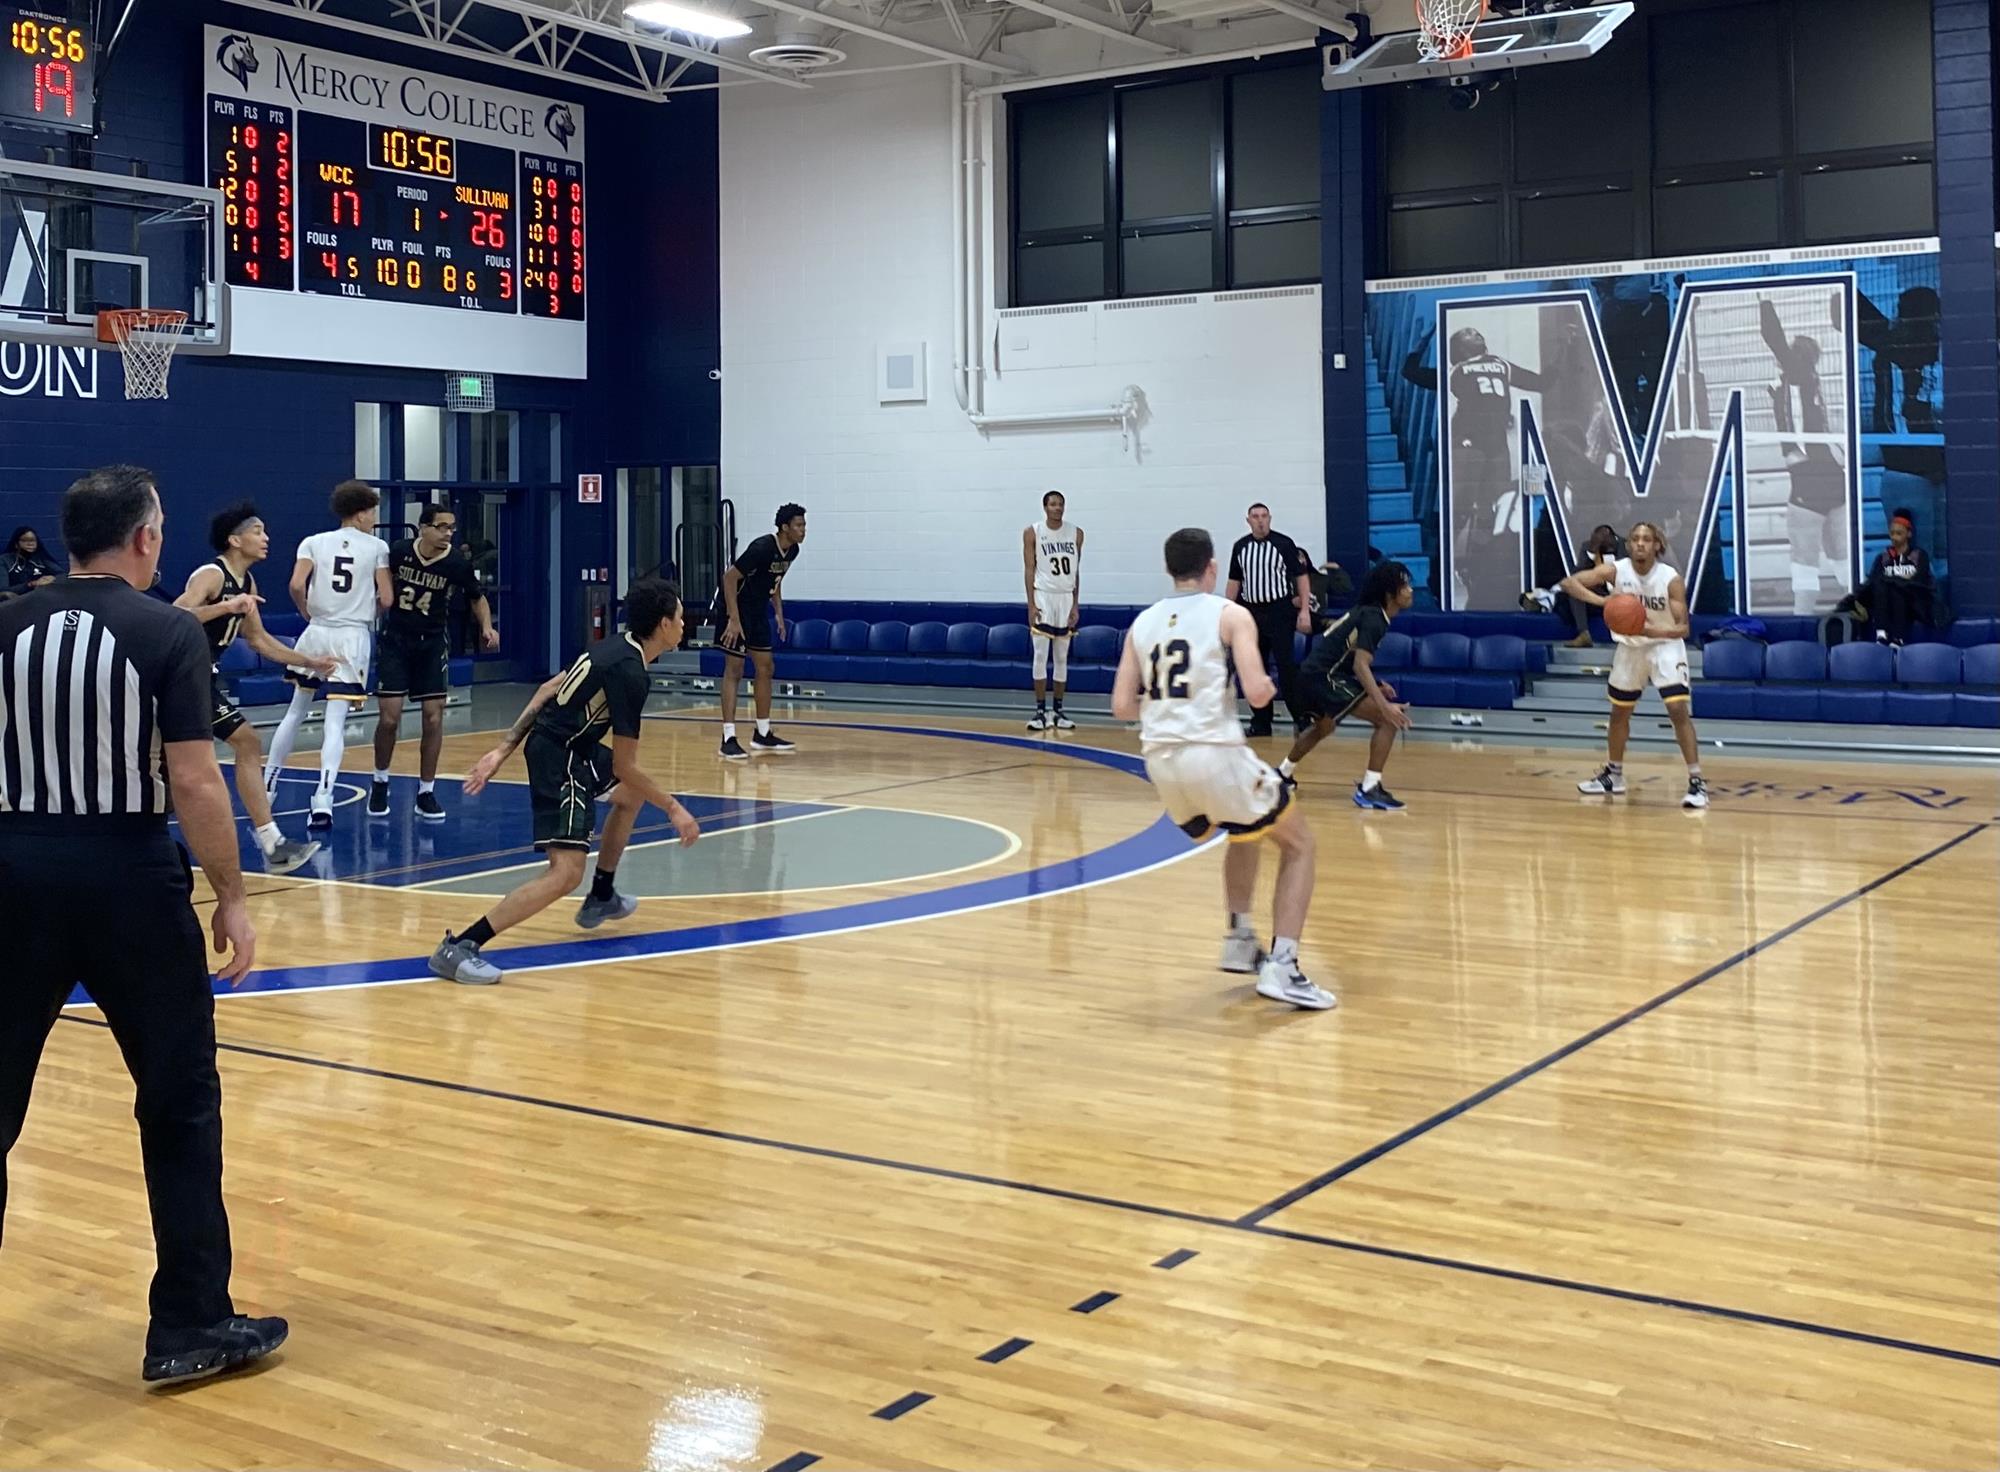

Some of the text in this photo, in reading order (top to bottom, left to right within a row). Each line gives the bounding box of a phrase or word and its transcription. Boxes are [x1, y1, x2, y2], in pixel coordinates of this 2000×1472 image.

[19, 9, 67, 23] DAKTRONICS
[12, 21, 84, 62] 10:56
[35, 61, 72, 117] 19
[274, 46, 535, 138] MERCY COLLEGE
[214, 100, 285, 124] PLYR FLS PTS
[232, 125, 289, 153] 1 0 2
[226, 150, 289, 180] 5 1 2
[383, 131, 451, 175] 10:56
[319, 163, 354, 185] WCC
[524, 157, 577, 177] PLYR FLS PTS
[245, 180, 257, 202] 0
[278, 185, 289, 206] 3
[397, 185, 428, 202] PERIOD
[455, 185, 509, 210] SULLIVAN
[533, 176, 581, 202] 0 0 0
[226, 204, 289, 233] 0 0 5
[333, 190, 360, 227] 17
[414, 207, 420, 232] 1
[534, 199, 542, 219] 3
[571, 206, 581, 225] 0
[306, 231, 338, 247] FOULS
[472, 211, 504, 248] 26
[529, 223, 543, 242] 10
[548, 225, 557, 244] 0
[252, 235, 258, 254] 1
[279, 237, 289, 259] 3
[371, 237, 451, 259] PLYR FOUL PTS
[528, 247, 543, 264] 11
[573, 251, 582, 270] 3
[245, 261, 258, 280] 4
[322, 252, 337, 278] 4
[347, 257, 359, 278] 5
[485, 254, 511, 268] FOULS
[377, 257, 457, 292] 10 0 8
[466, 271, 476, 291] 6
[500, 272, 512, 299] 3
[525, 268, 582, 293] 24 0 0
[340, 283, 366, 297] T.O.L.
[460, 296, 483, 309] T.O.L.
[550, 294, 558, 314] 3
[1041, 542, 1075, 556] VIKINGS
[332, 555, 354, 593] 5
[398, 565, 448, 590] SULLIVAN
[1050, 556, 1071, 576] 30
[399, 586, 432, 616] 24
[1640, 595, 1666, 611] INGS
[1149, 639, 1190, 700] 12
